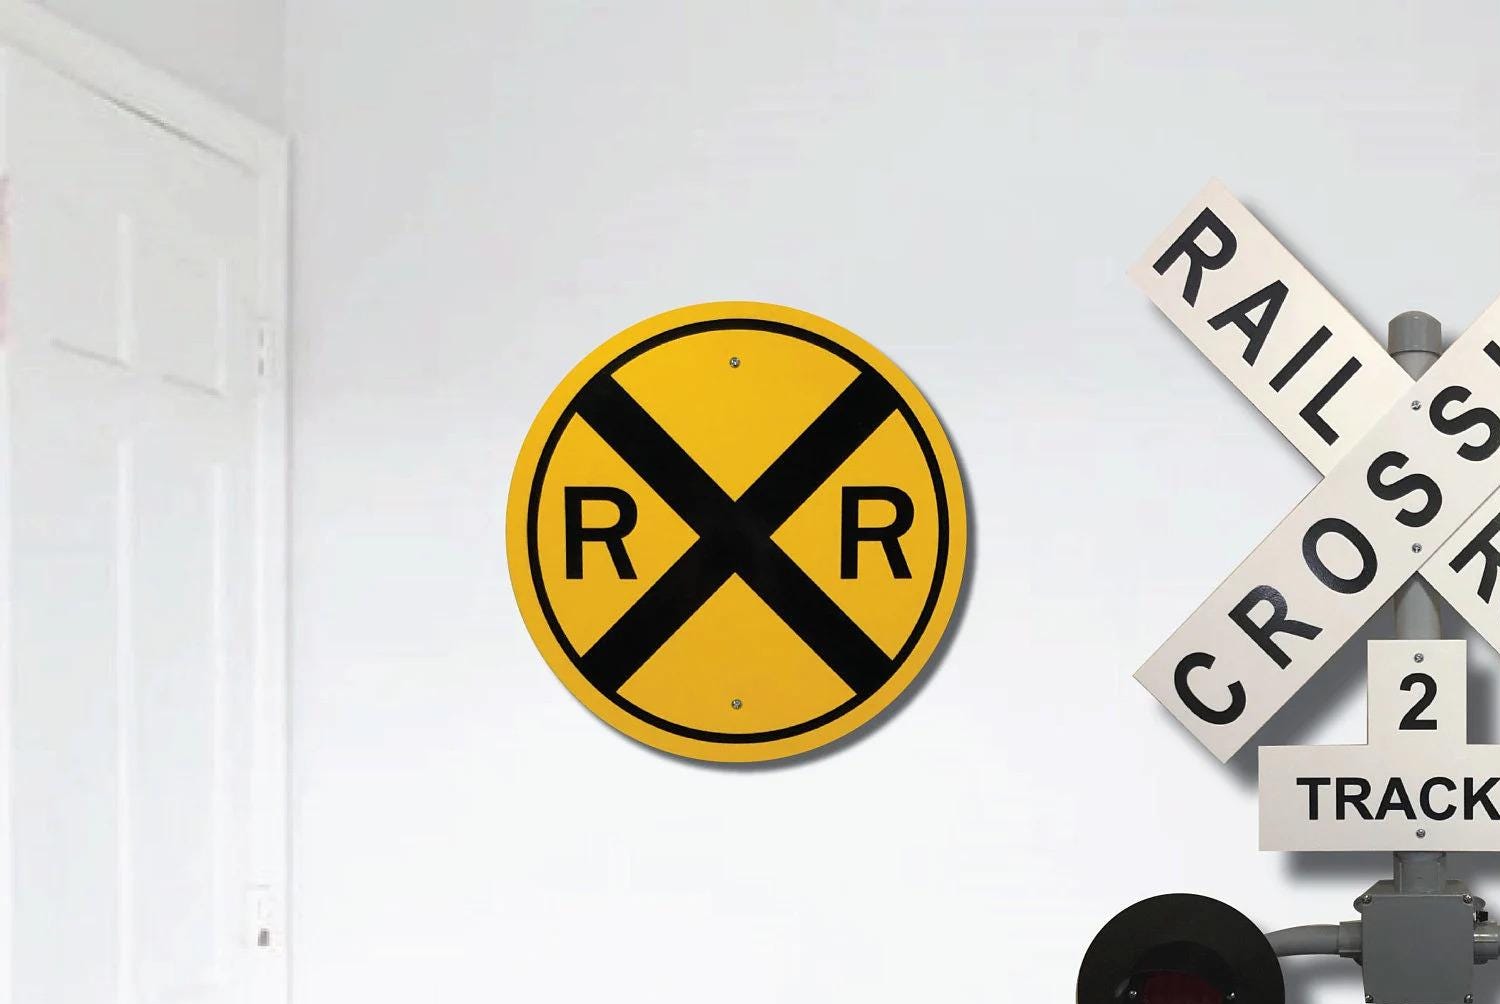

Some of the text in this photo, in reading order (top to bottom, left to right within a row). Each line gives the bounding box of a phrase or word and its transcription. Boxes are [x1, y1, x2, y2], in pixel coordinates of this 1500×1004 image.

[1152, 206, 1362, 446] RAIL
[564, 486, 915, 580] R R
[1399, 672, 1438, 730] 2
